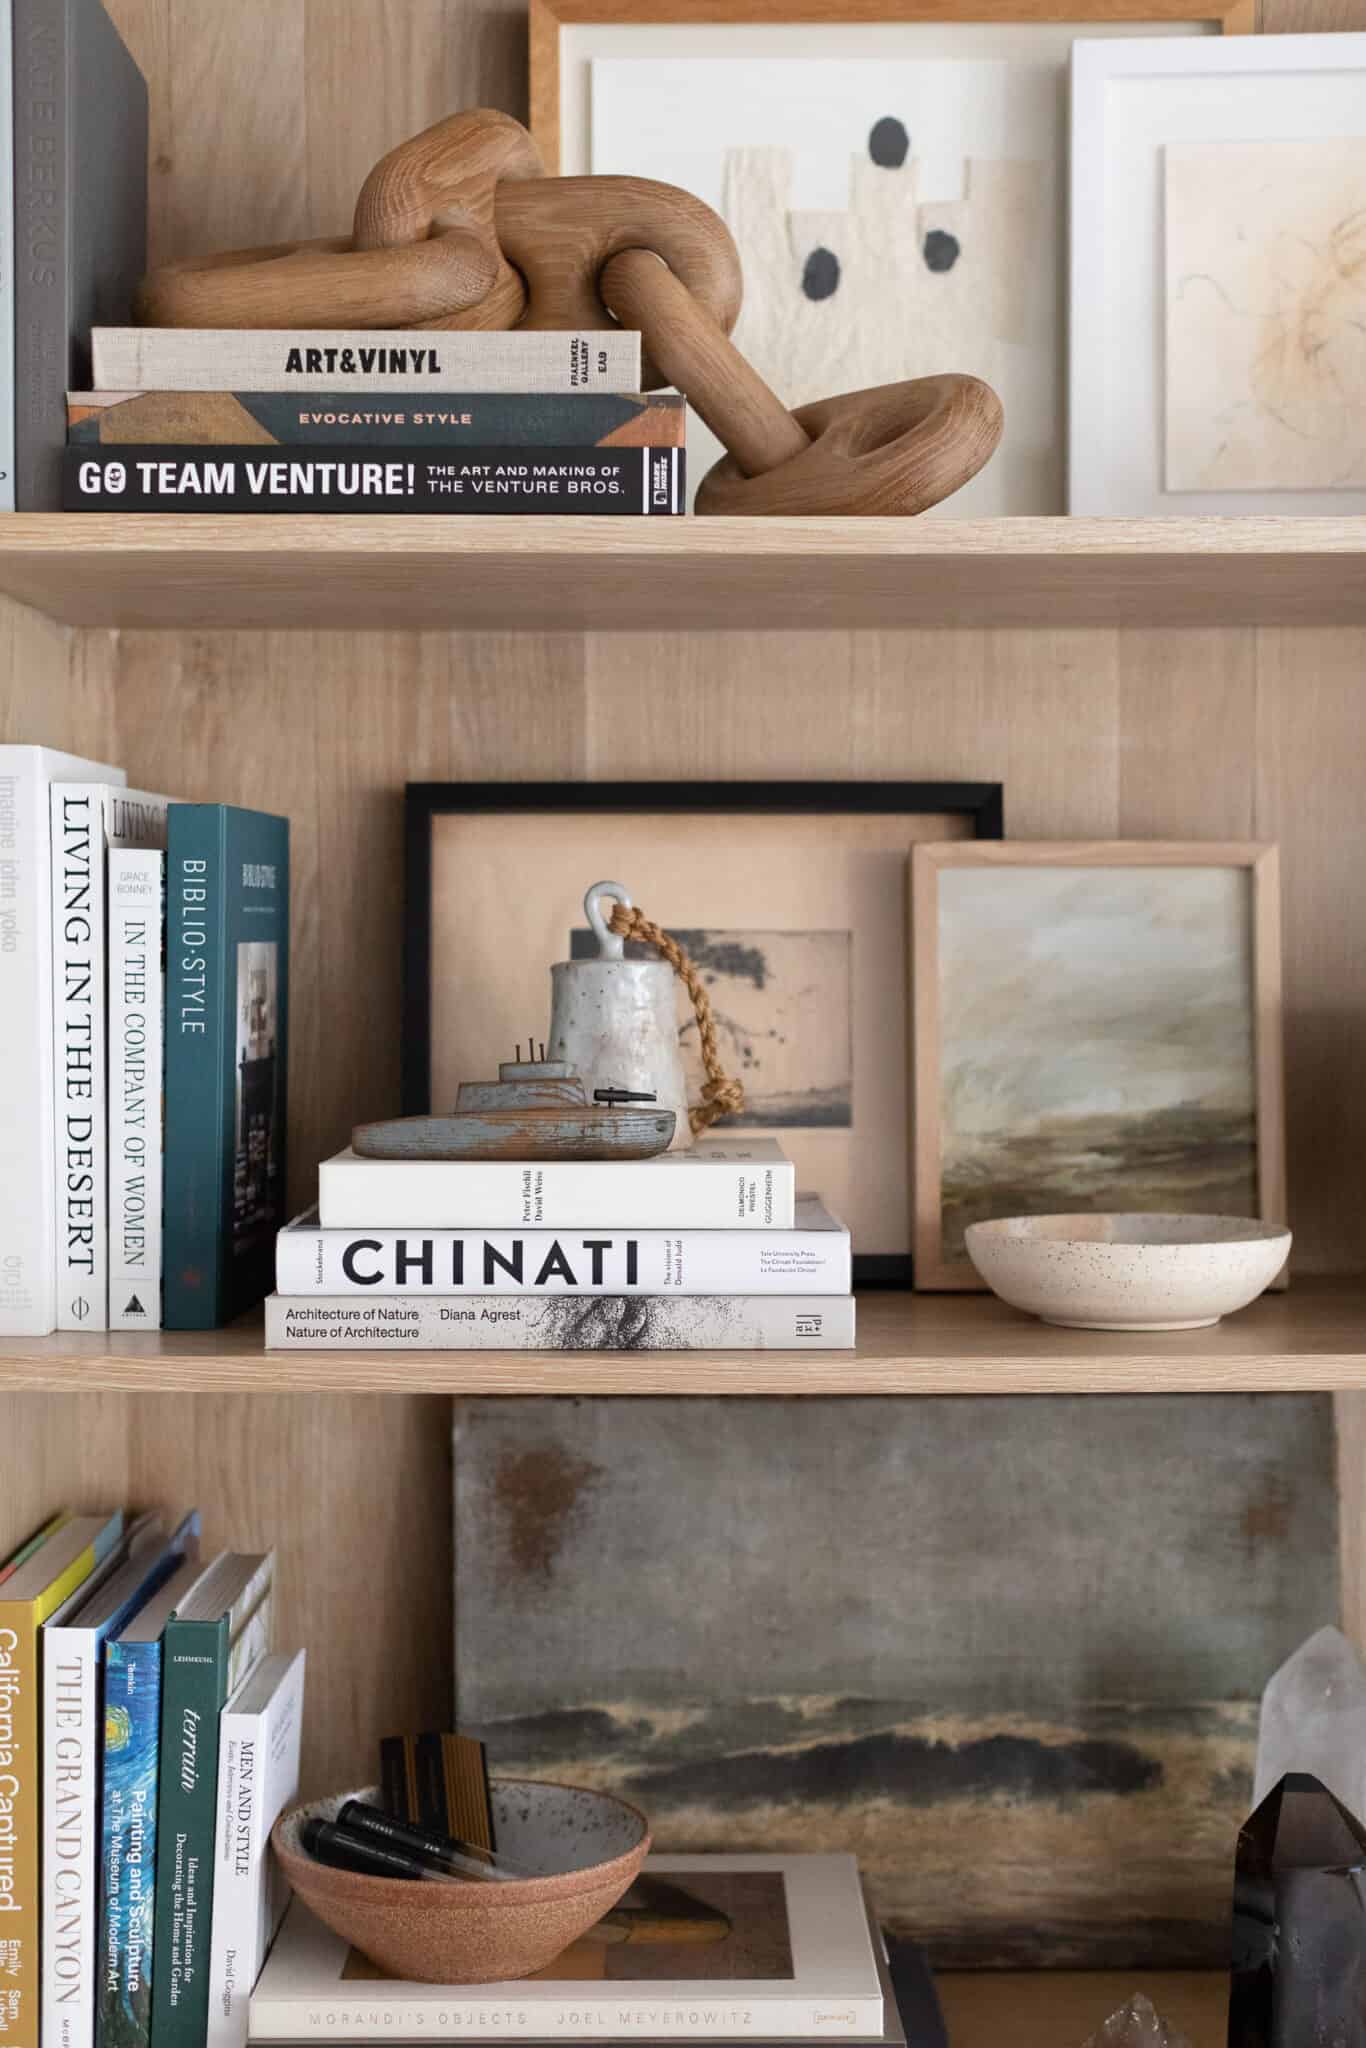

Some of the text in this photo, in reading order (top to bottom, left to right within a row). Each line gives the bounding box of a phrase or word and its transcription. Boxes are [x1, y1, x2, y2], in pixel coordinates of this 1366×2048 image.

[285, 347, 442, 375] ART&VINYL
[570, 338, 580, 387] FRAENKEL
[581, 340, 589, 384] GALLERY
[299, 413, 472, 425] EVOCATIVE STYLE
[79, 462, 416, 495] GO TEAM VENTURE!
[427, 466, 621, 476] THE ART AND MAKING OF
[427, 481, 625, 494] THE VENTURE BROS.
[117, 884, 153, 895] BONNEY
[119, 871, 149, 882] GRACE
[63, 796, 94, 1275] LIVING IN THE DESERT
[124, 921, 146, 1266] IN THE COMPANY OF WOMEN
[534, 1171, 543, 1222] David Weiss
[342, 1239, 640, 1287] CHINATI
[674, 1258, 682, 1286] Donald
[286, 1308, 419, 1321] Architecture of Nature
[440, 1308, 521, 1323] Diana Agrest
[286, 1326, 419, 1339] Nature of Architecture
[180, 1708, 201, 1794] terrain
[235, 1740, 254, 1876] MEN AND STYLE
[55, 1656, 82, 2004] THE GRAND CANYON
[108, 1790, 123, 1993] at The Museum of Modern Art
[125, 1790, 147, 1993] Painting and Sculpture
[170, 1832, 187, 2006] Decorating the Home and Garden
[183, 1857, 199, 1984] Ideas and Inspiration for
[5, 1938, 22, 1977] Emily
[225, 1949, 237, 1977] David
[8, 1990, 21, 2020] Sam
[309, 2013, 529, 2025] MORANDI'S OBJECTS
[556, 2012, 753, 2025] JOEL MEYEROWITZ
